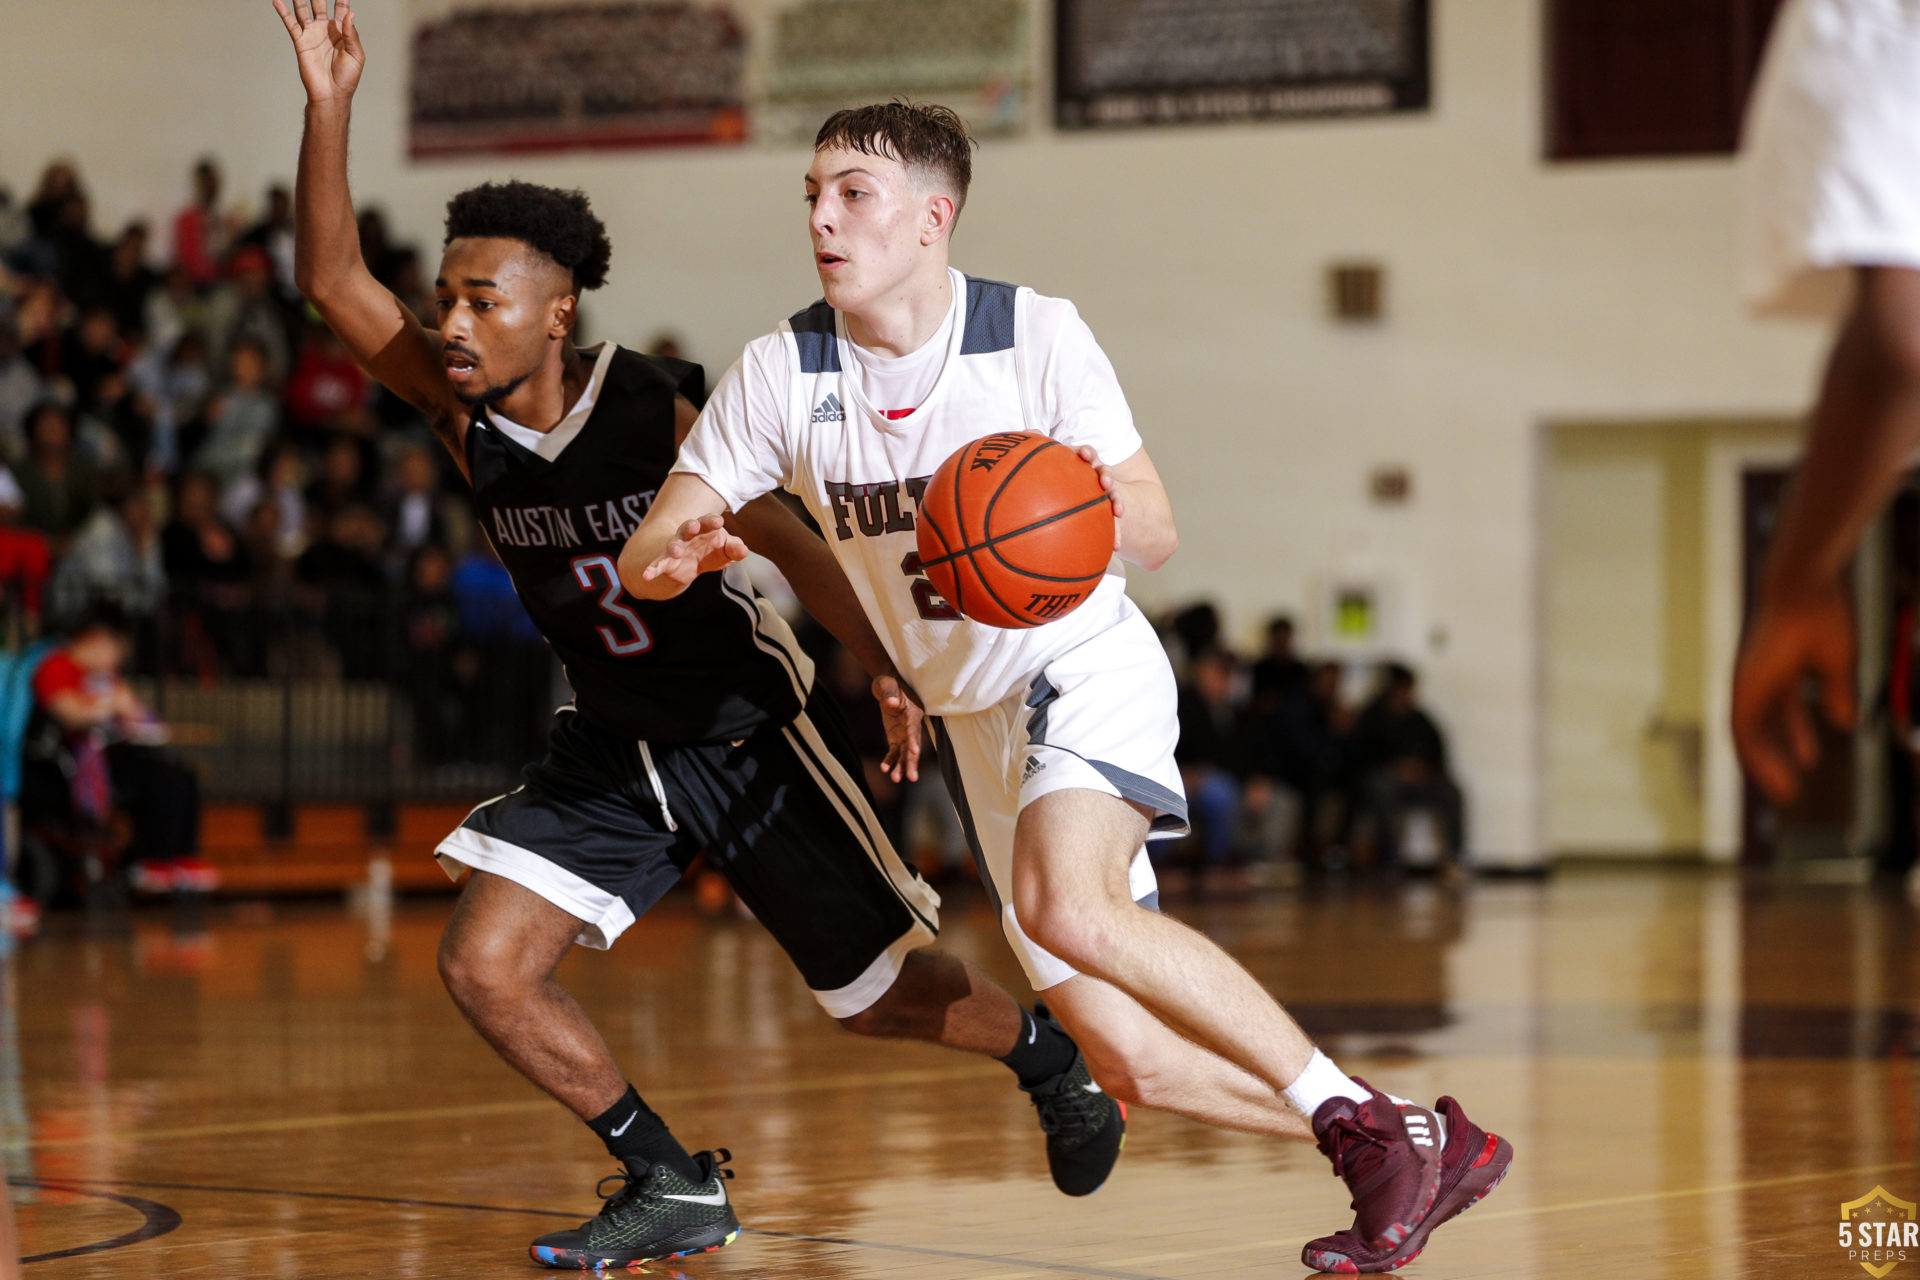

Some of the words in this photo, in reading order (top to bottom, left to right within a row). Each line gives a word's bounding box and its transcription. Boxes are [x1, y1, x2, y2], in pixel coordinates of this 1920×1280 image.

[492, 506, 583, 548] AUSTIN
[570, 553, 653, 657] 3
[1024, 593, 1081, 619] THE
